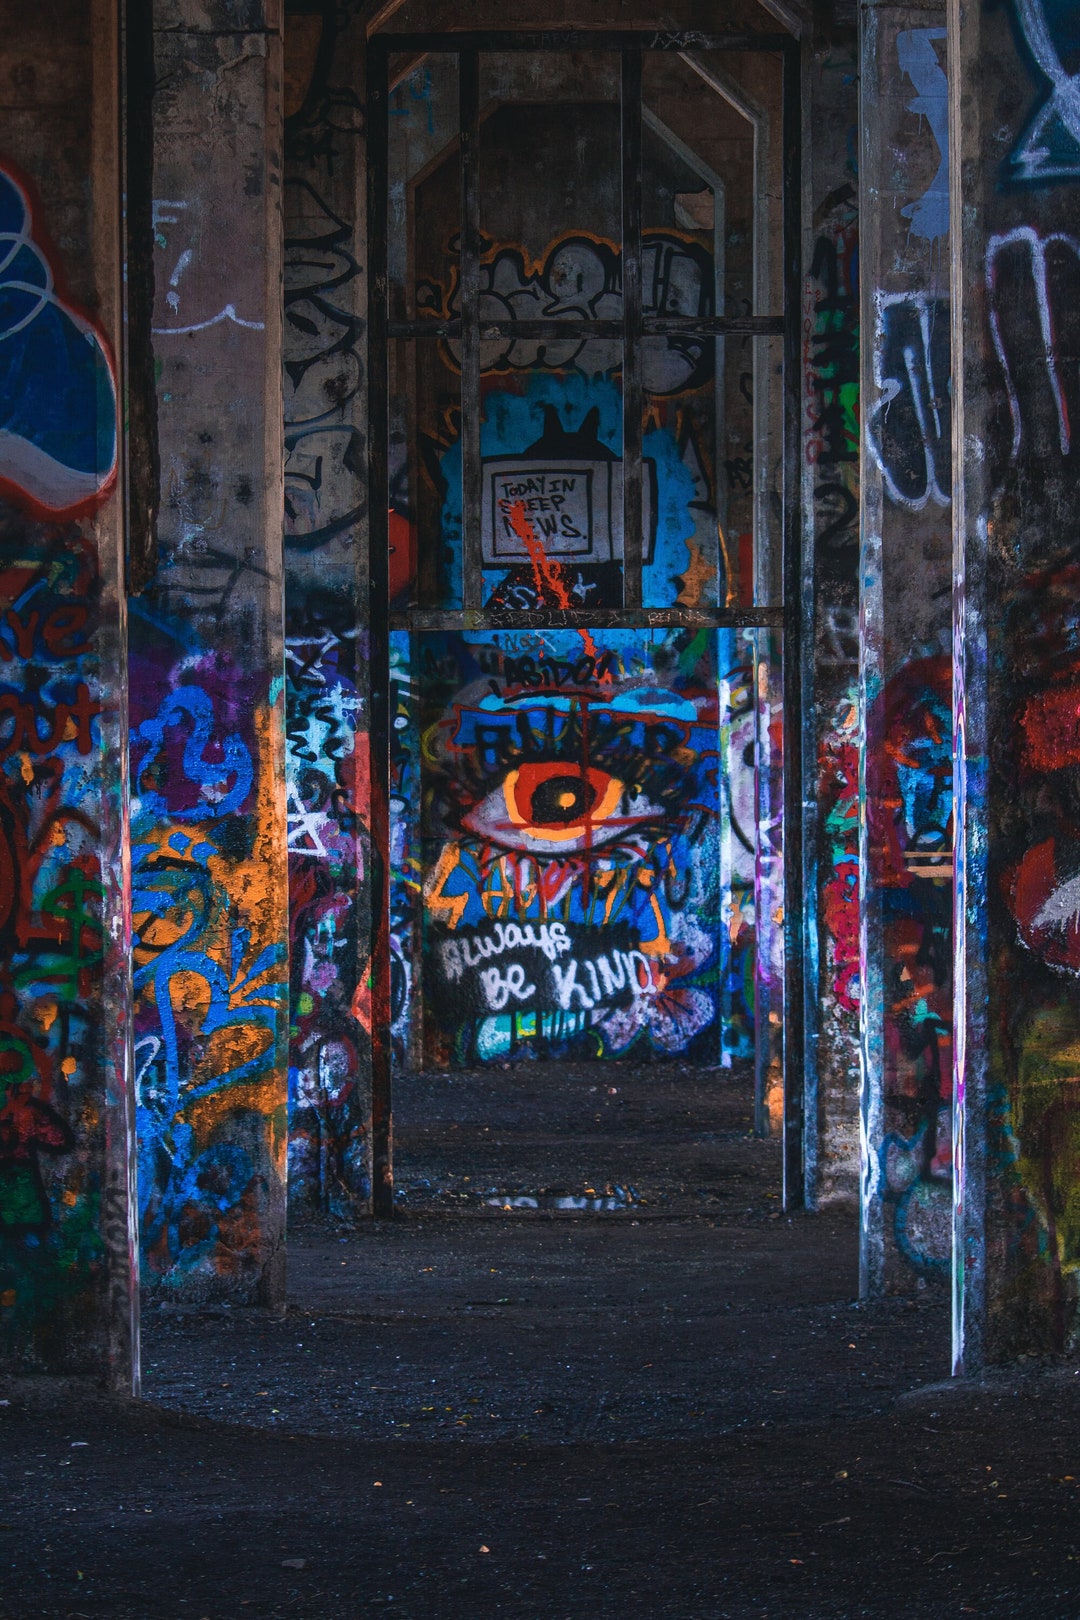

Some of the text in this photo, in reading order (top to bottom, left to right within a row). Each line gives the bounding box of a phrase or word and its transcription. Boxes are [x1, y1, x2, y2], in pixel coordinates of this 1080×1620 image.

[549, 478, 576, 493] IN
[499, 494, 566, 514] SEEP
[551, 949, 657, 1010] KIND
